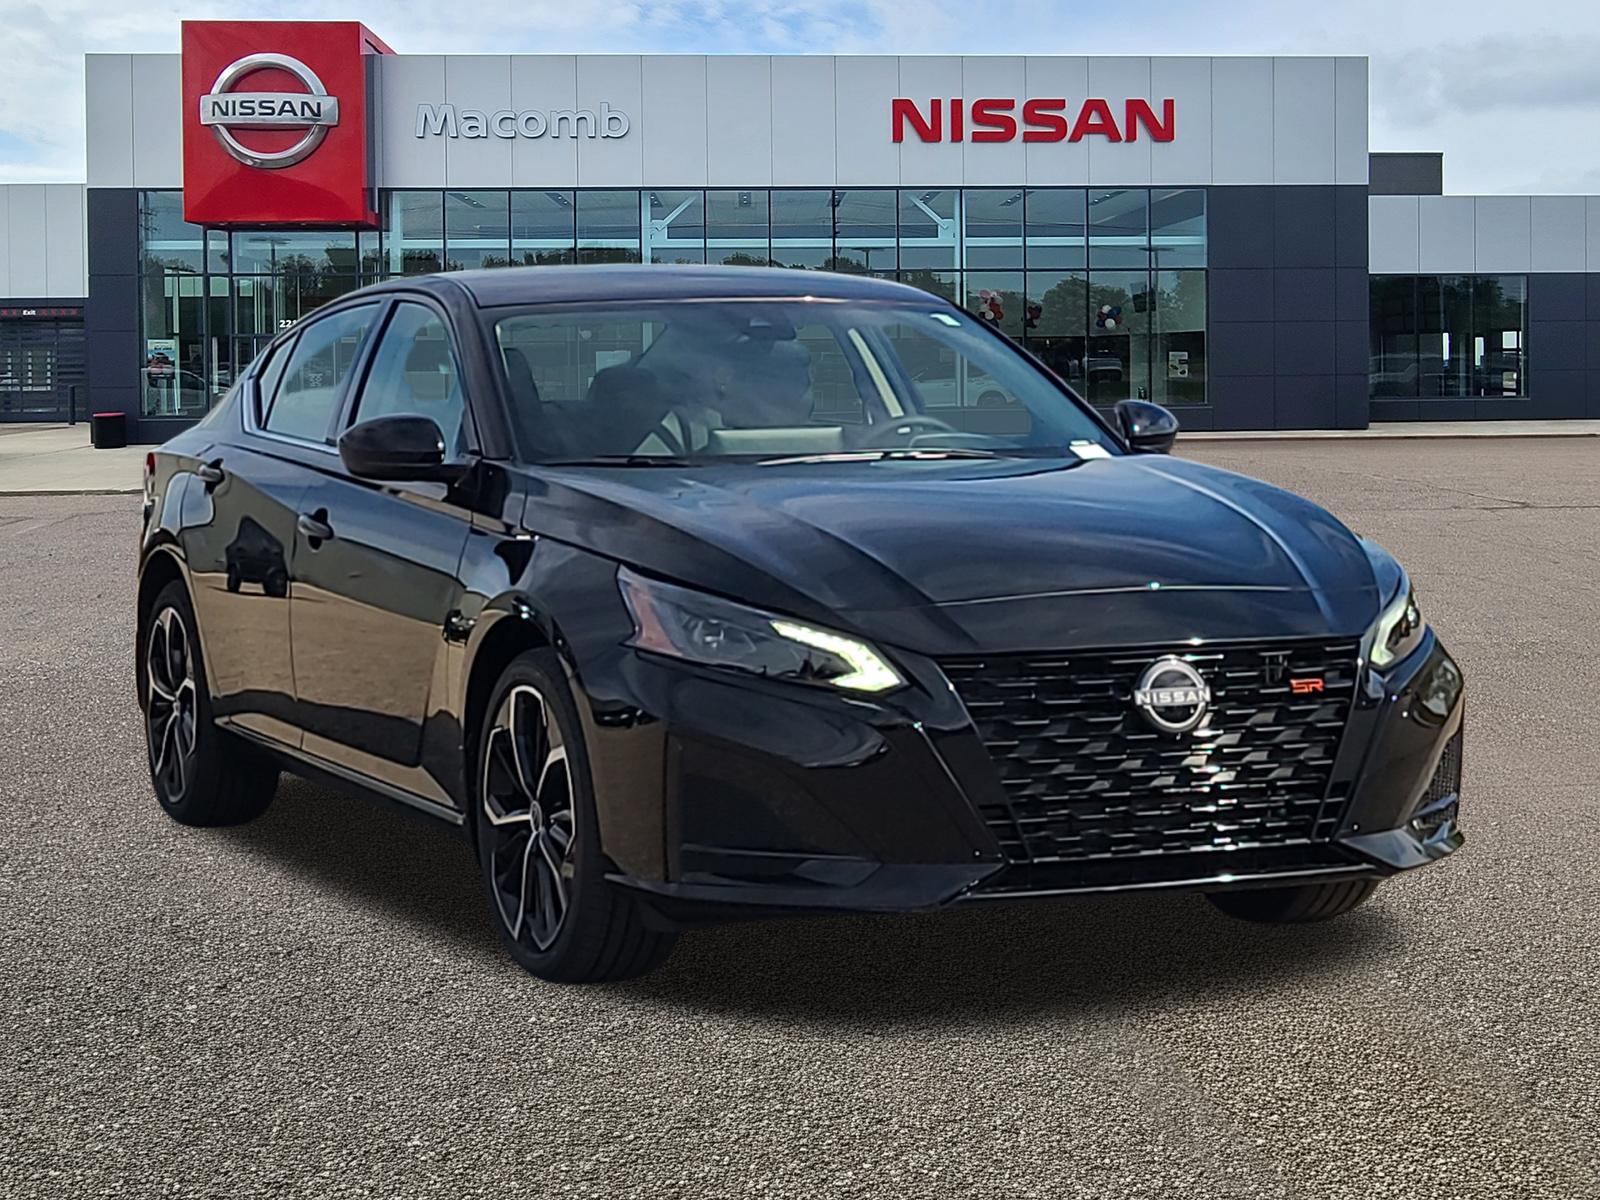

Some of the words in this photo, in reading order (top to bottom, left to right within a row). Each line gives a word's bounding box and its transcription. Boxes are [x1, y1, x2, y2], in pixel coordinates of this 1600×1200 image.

[211, 100, 322, 118] NISSAN
[415, 102, 630, 138] Macomb
[892, 98, 1175, 143] NISSAN
[1134, 685, 1211, 706] NISSAN
[1290, 678, 1325, 693] SR
